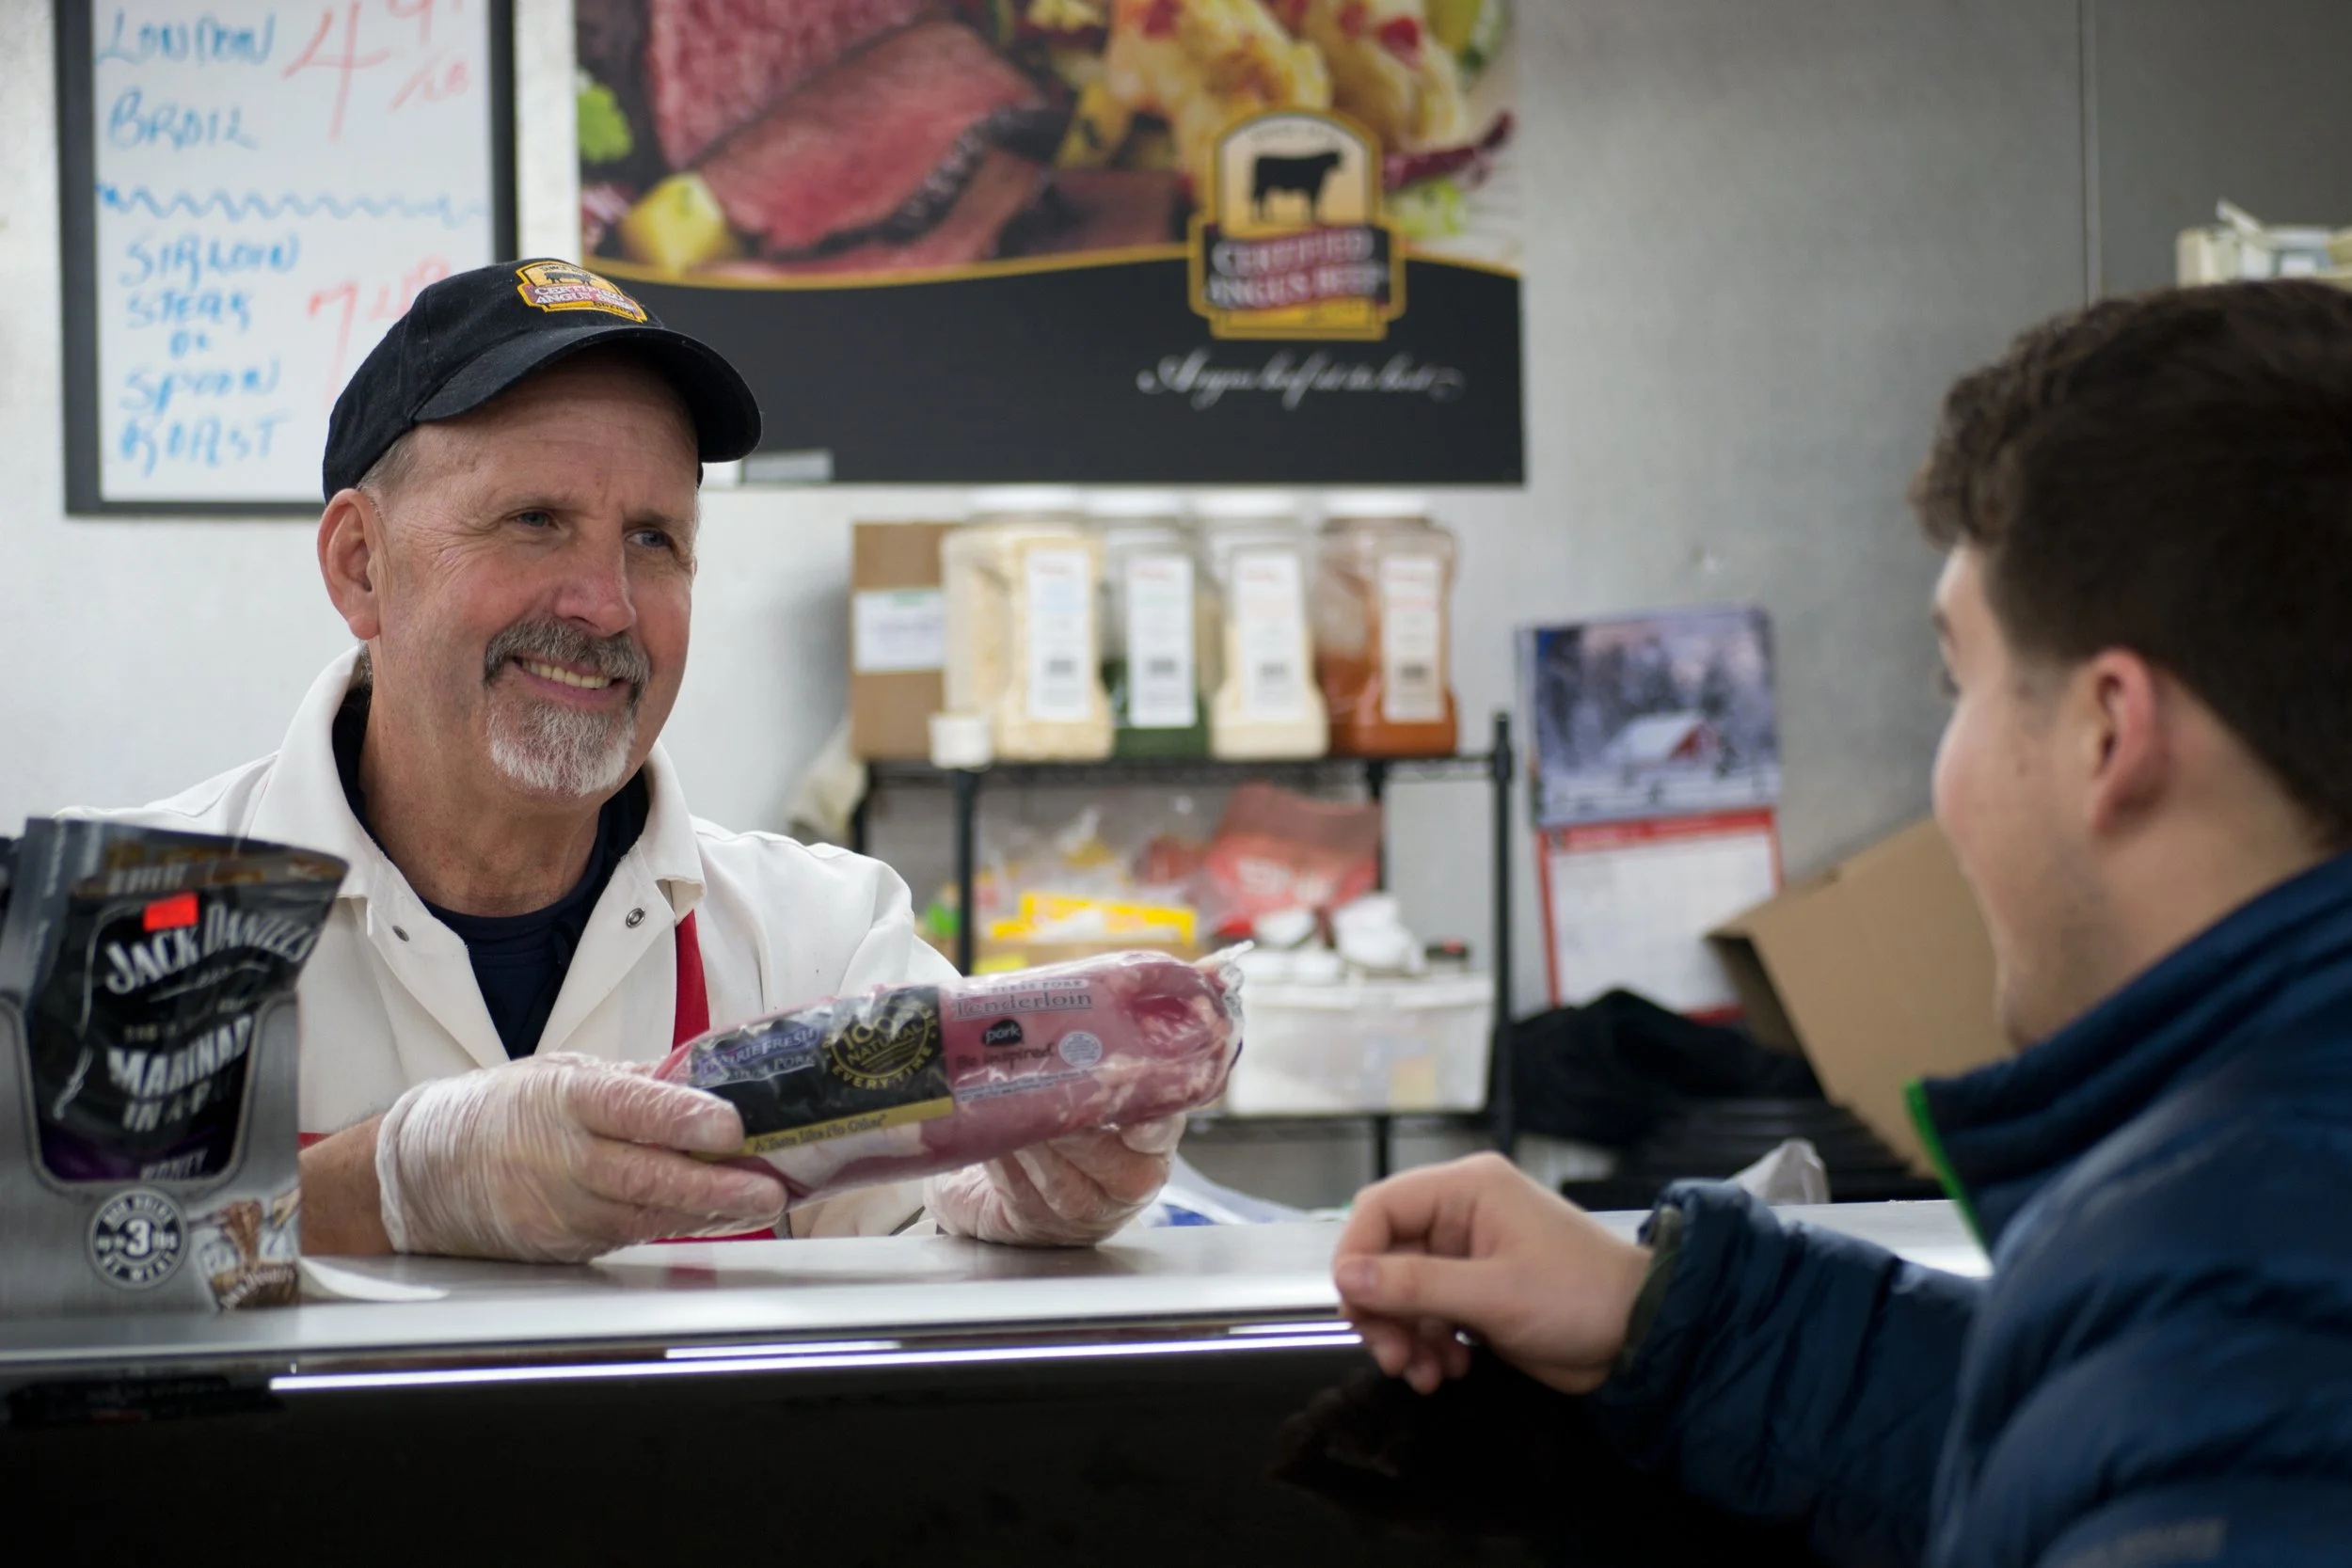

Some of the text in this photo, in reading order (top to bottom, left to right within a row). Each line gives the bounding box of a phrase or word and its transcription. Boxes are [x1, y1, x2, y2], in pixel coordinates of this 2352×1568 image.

[108, 85, 259, 152] BROIL
[536, 293, 593, 304] ANGUS
[106, 927, 199, 994] JACK
[952, 991, 1092, 1017] Tenderloin
[985, 1025, 1021, 1045] pork
[107, 1014, 252, 1099] MARINAD
[125, 1219, 151, 1256] 3
